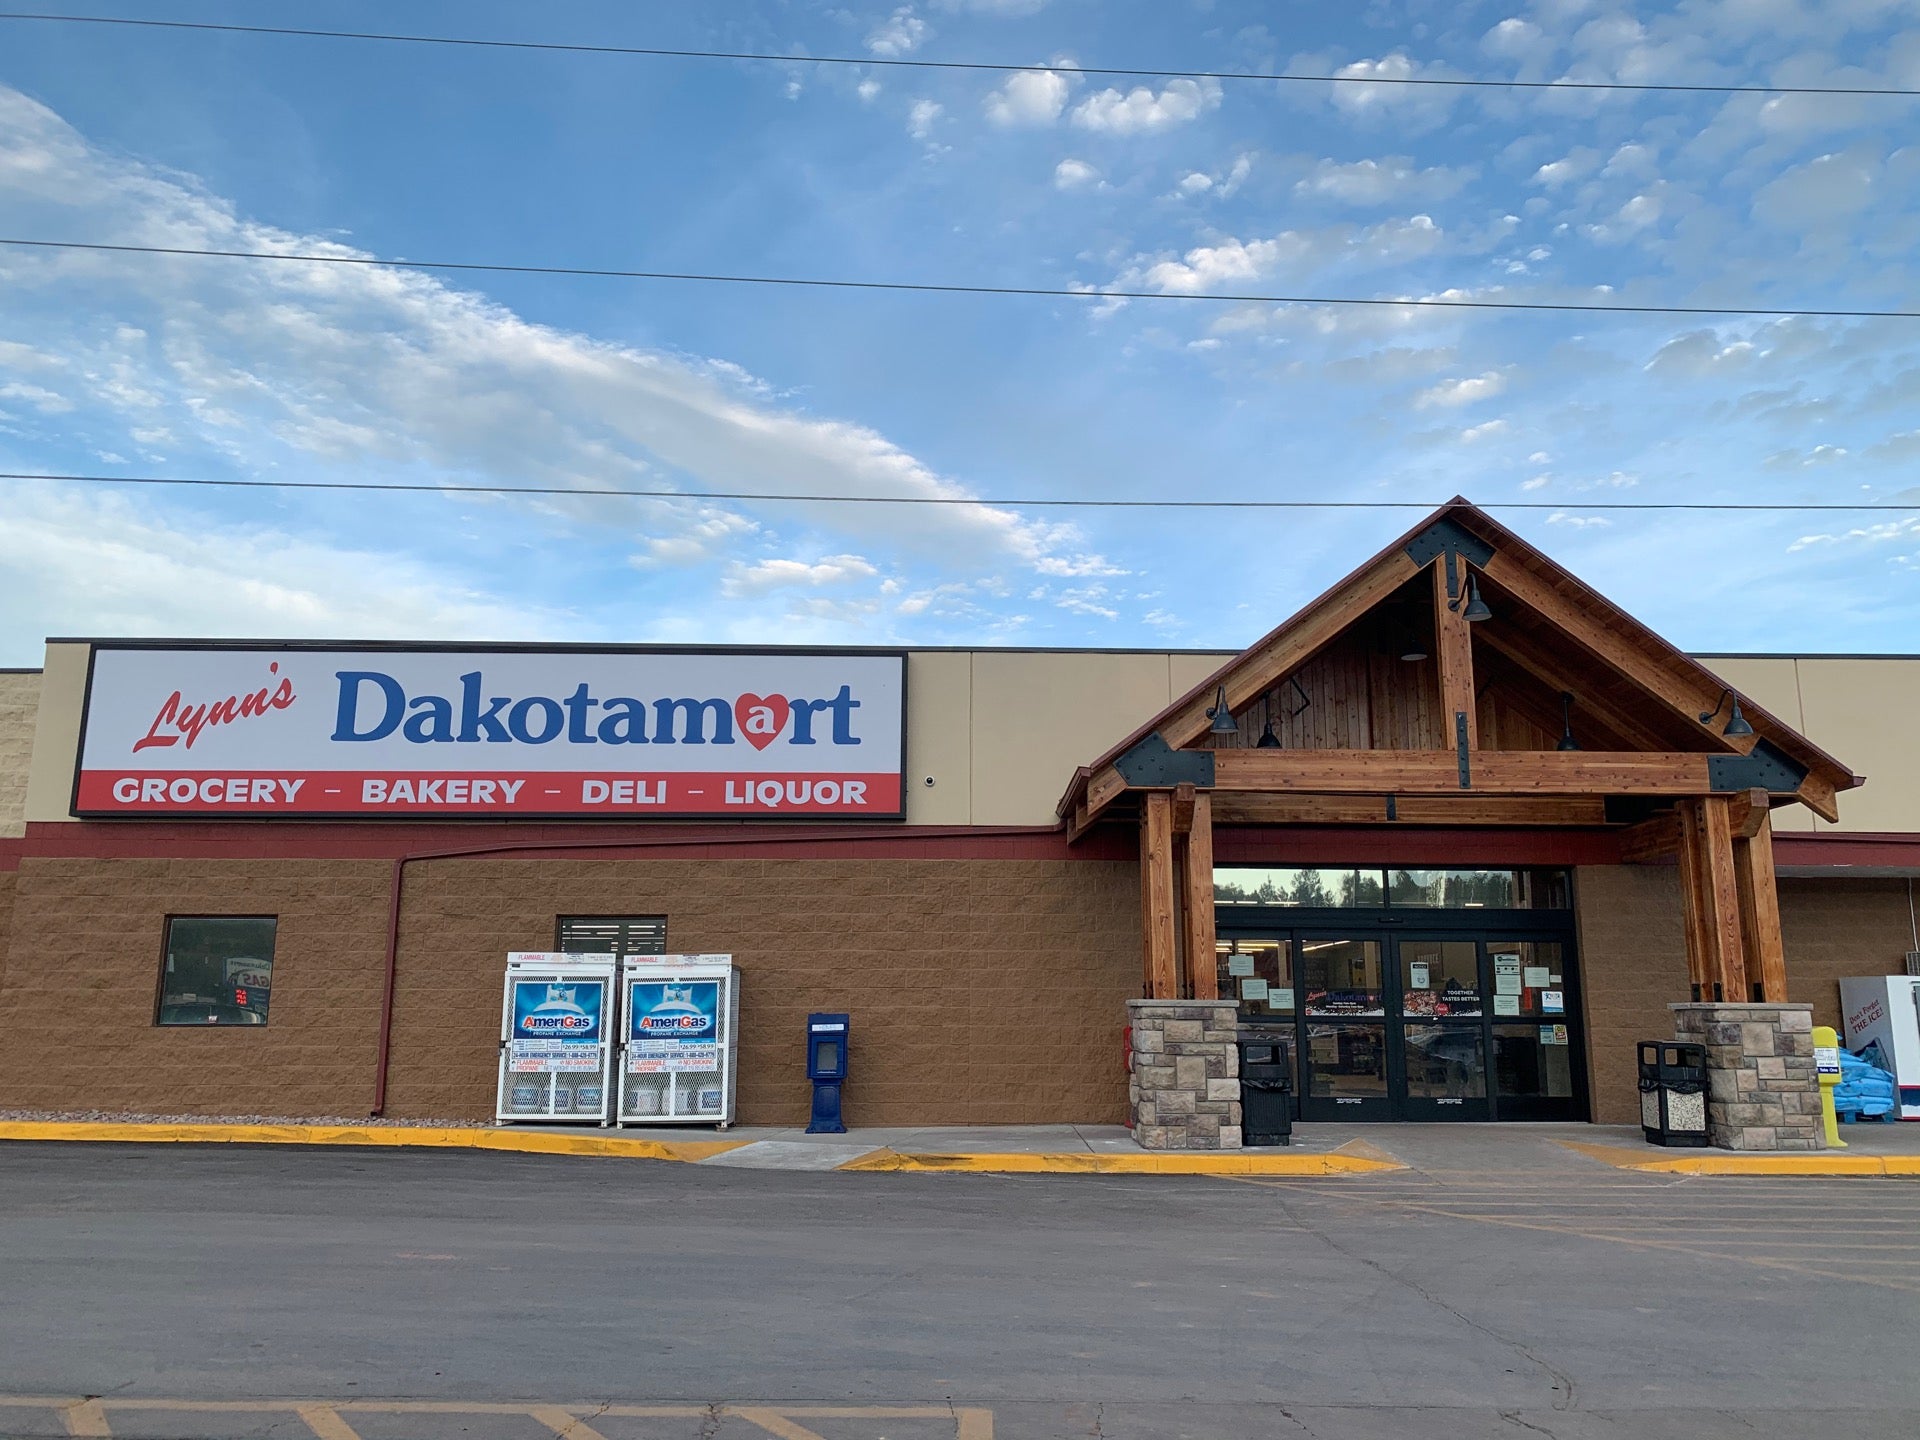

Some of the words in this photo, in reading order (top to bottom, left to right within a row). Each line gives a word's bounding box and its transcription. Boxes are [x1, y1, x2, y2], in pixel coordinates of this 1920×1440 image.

[132, 662, 296, 753] Lynn's
[330, 671, 861, 746] Dakotamart
[112, 778, 306, 804] GROCERY
[361, 779, 526, 804] BAKERY
[581, 780, 667, 804] DELI
[725, 780, 867, 807] LIQUOR
[523, 1016, 590, 1028] AmeriGas
[641, 1016, 707, 1028] AmeriGas
[1852, 1016, 1869, 1034] THE
[1868, 1006, 1884, 1024] ICE!
